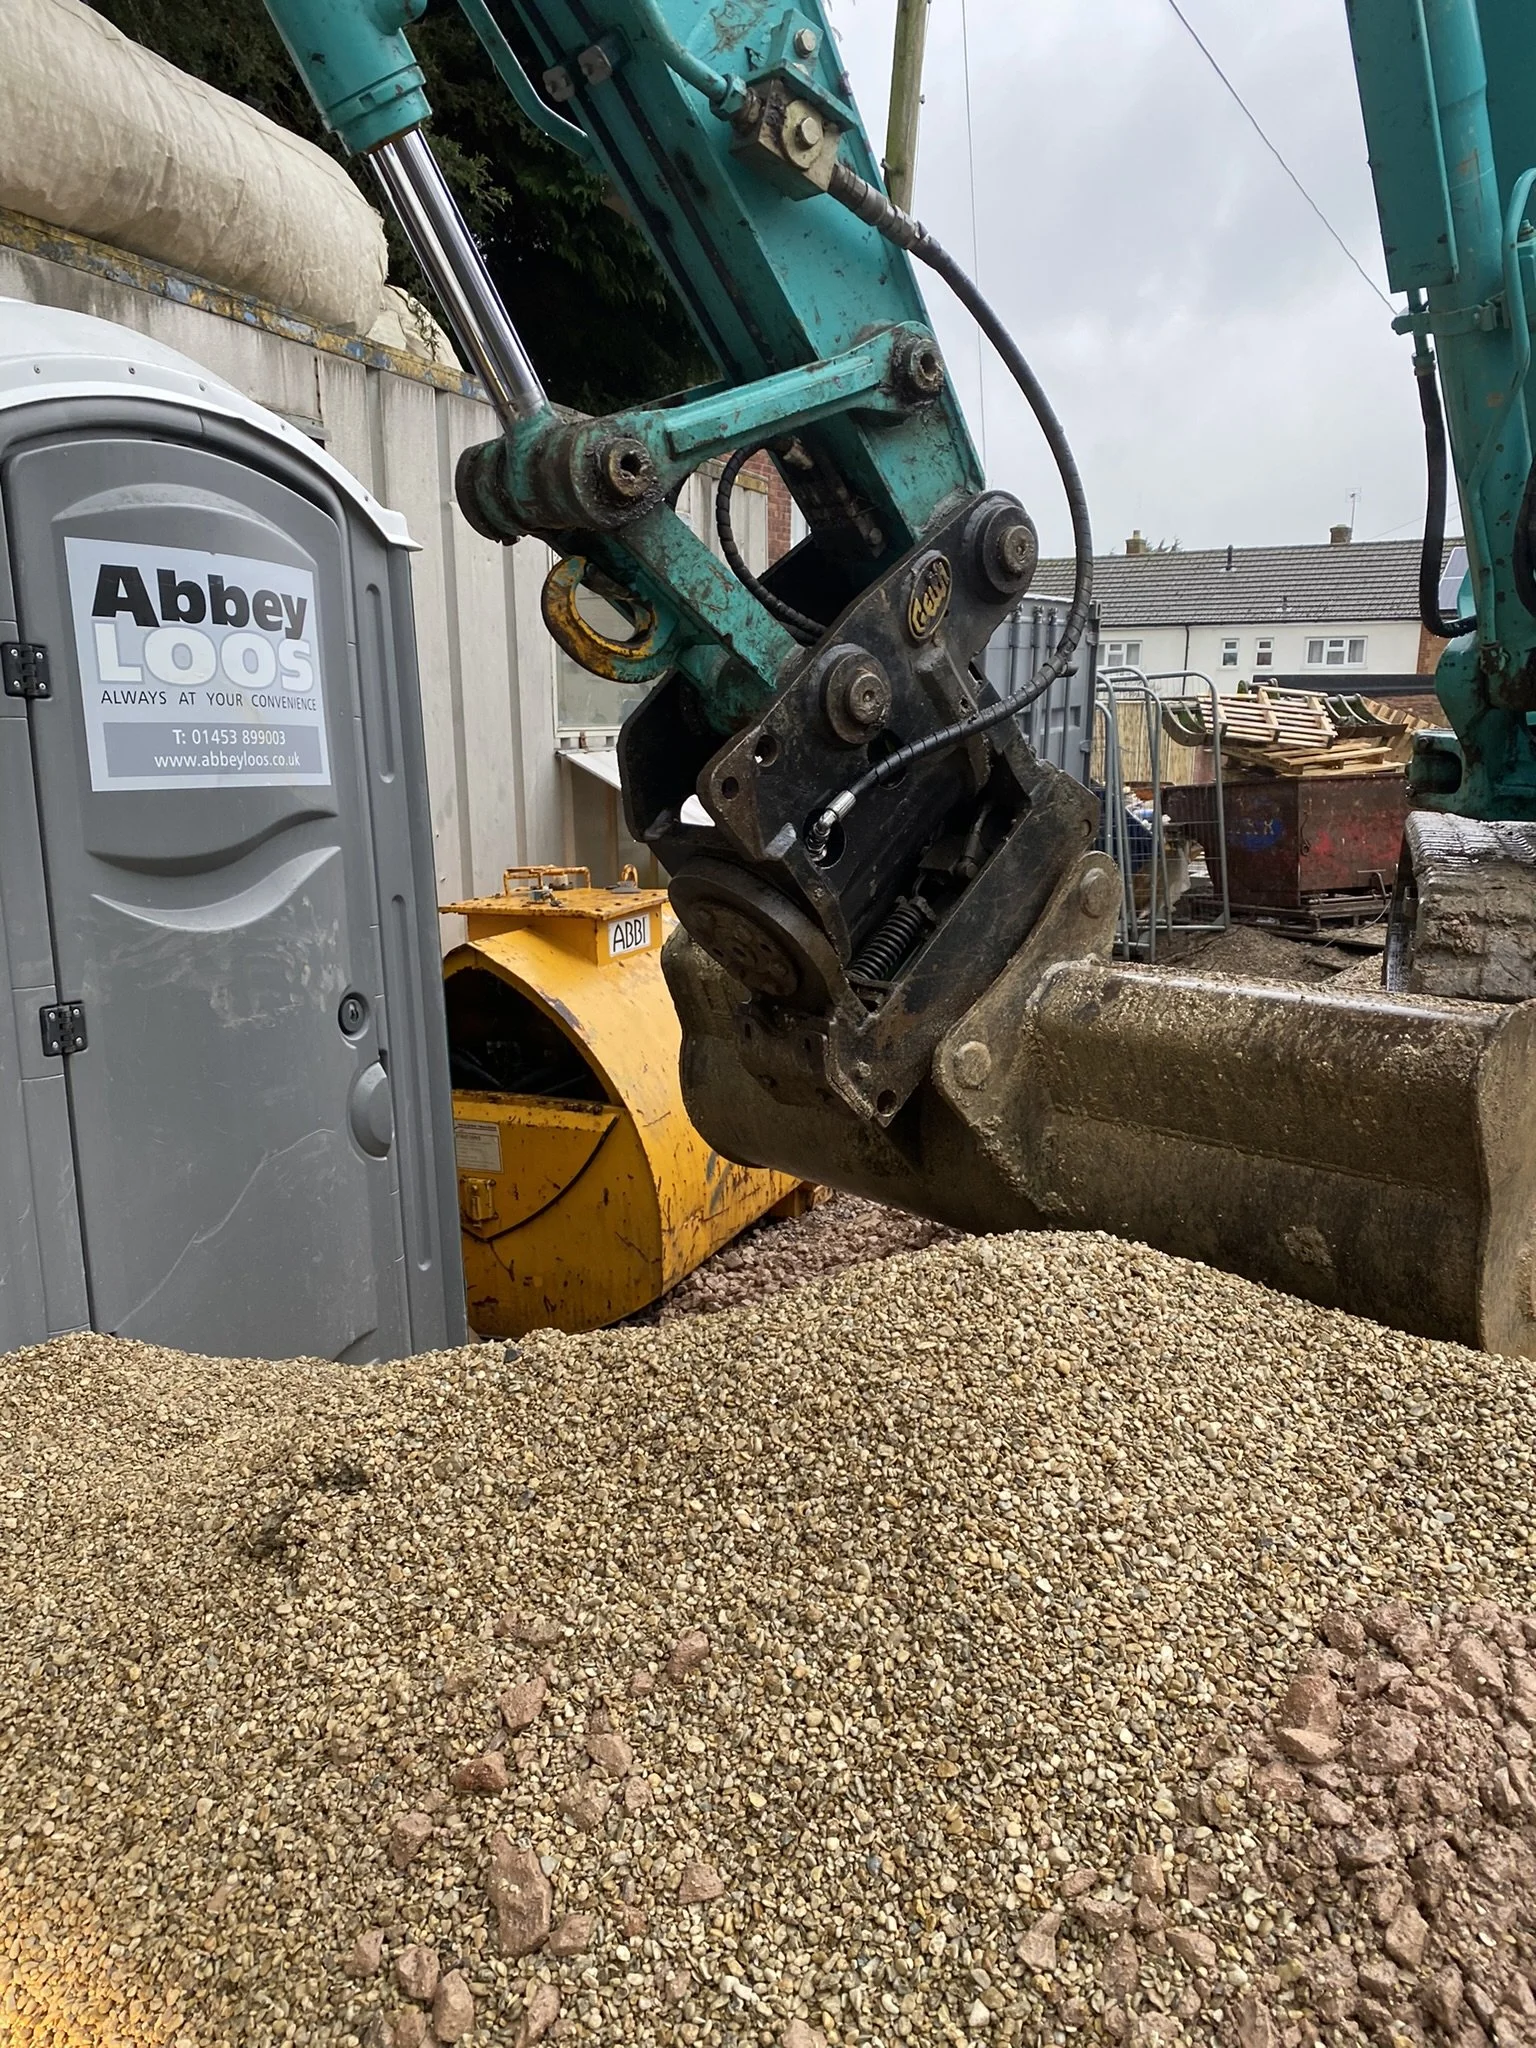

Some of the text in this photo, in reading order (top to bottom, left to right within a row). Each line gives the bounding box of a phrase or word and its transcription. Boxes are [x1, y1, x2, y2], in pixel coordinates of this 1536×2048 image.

[92, 563, 308, 640] Abbey
[92, 620, 316, 693] LOOS
[100, 690, 317, 711] ALWAYS AT YOUR CONVENIENCE
[172, 729, 286, 745] T: 01453 899003
[154, 750, 301, 771] www.abbeyloos.co.uk
[613, 917, 646, 952] ABBI
